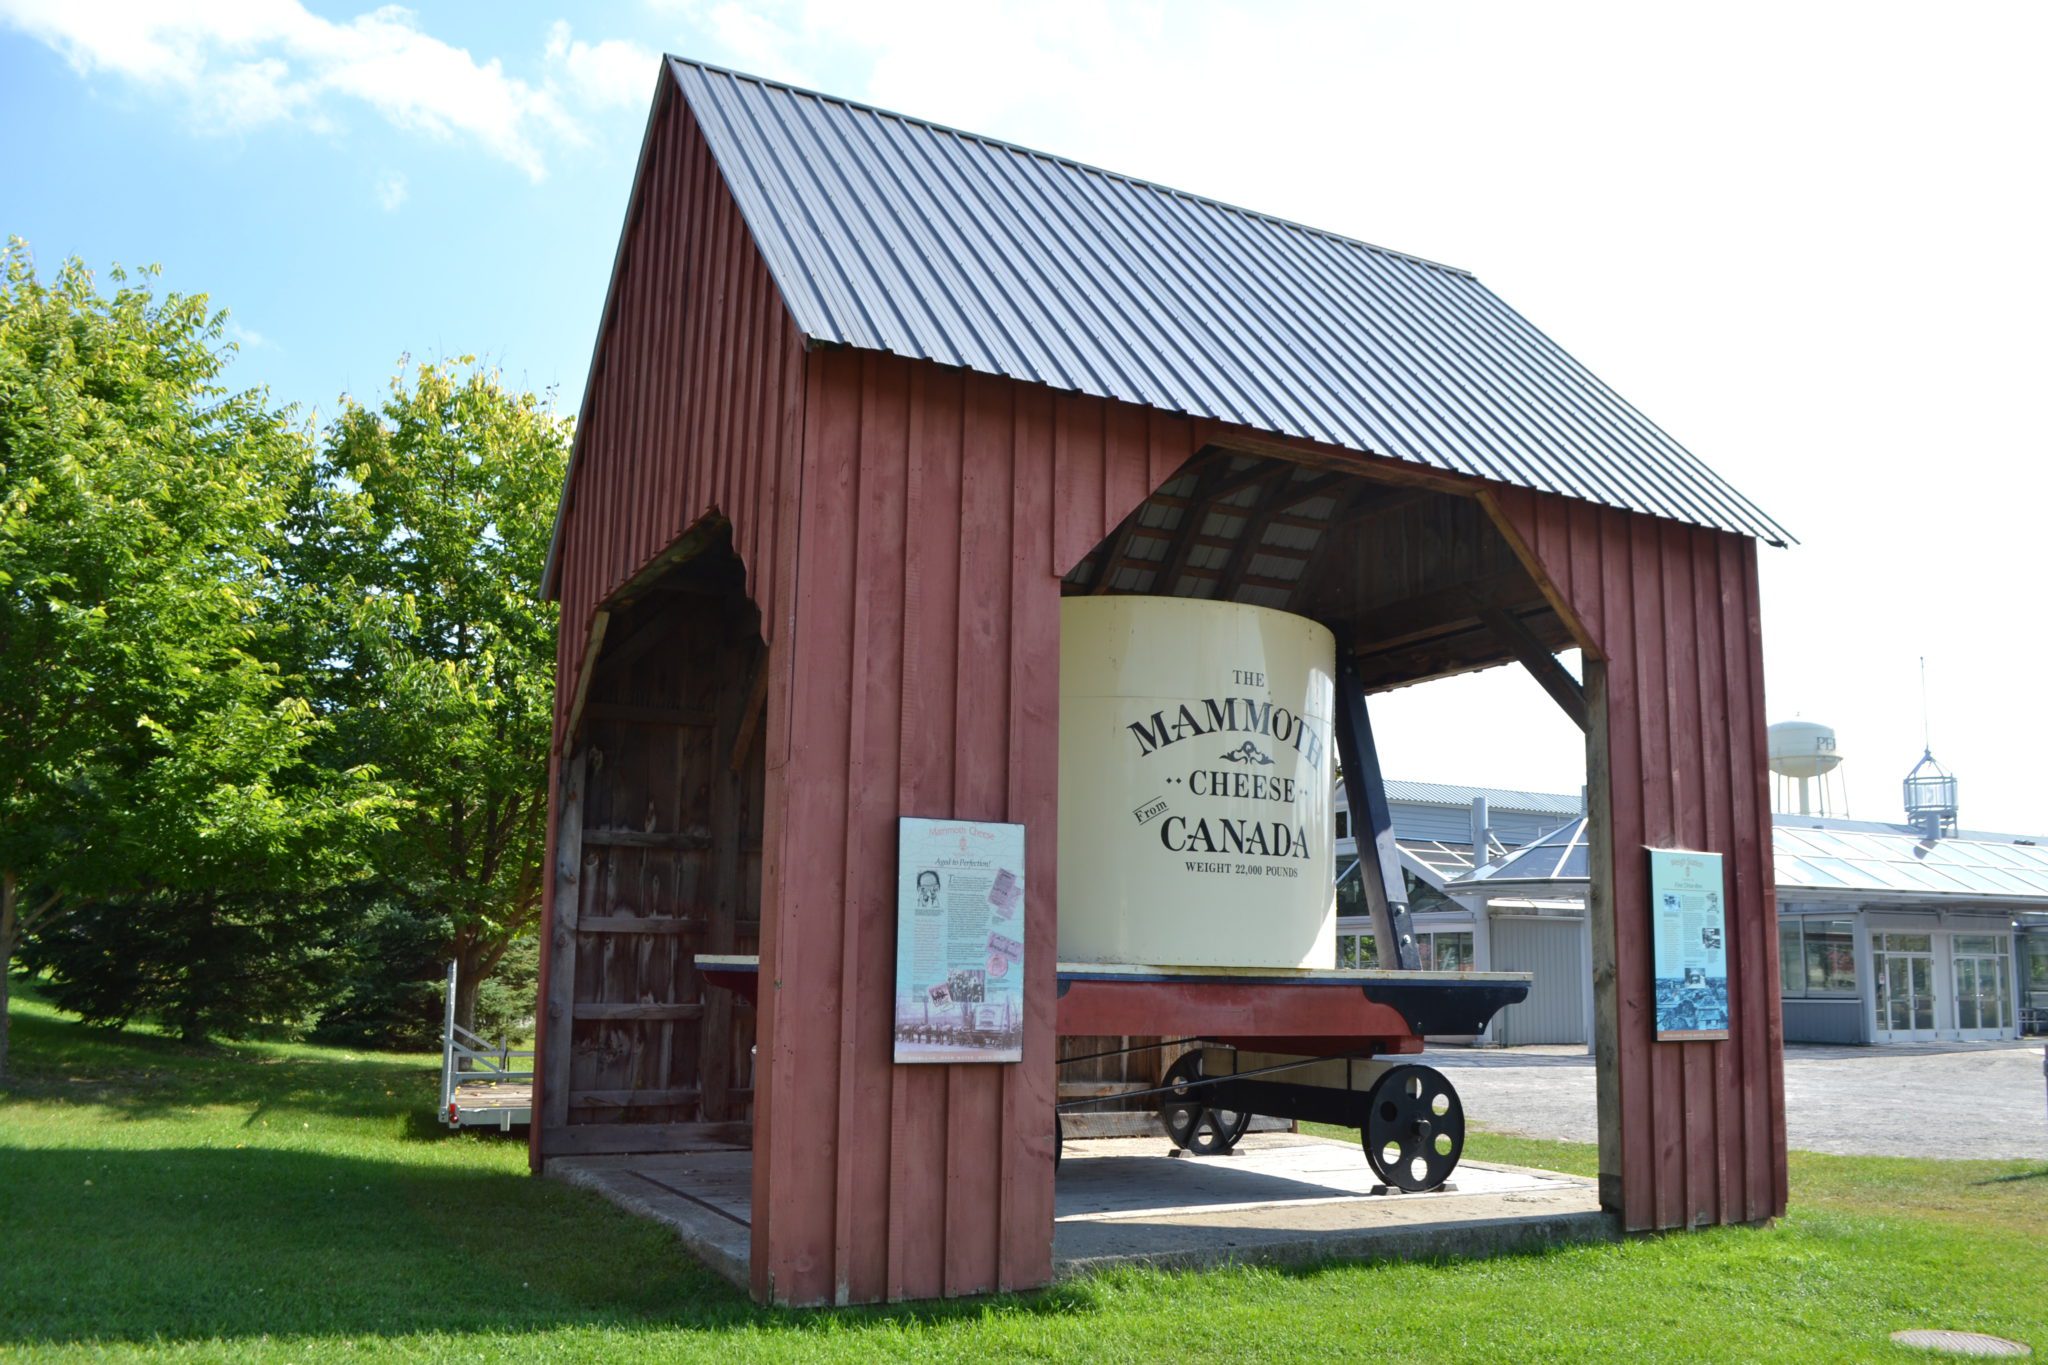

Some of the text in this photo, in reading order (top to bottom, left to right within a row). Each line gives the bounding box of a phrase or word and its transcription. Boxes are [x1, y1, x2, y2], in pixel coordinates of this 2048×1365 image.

[1232, 669, 1265, 688] THE
[1126, 697, 1324, 771] MAMMOTH
[1189, 769, 1296, 804] CHEESE
[1133, 799, 1168, 825] From
[1160, 815, 1311, 860] CANADA
[1185, 861, 1298, 878] WEIGHT 22,000 POUNDS
